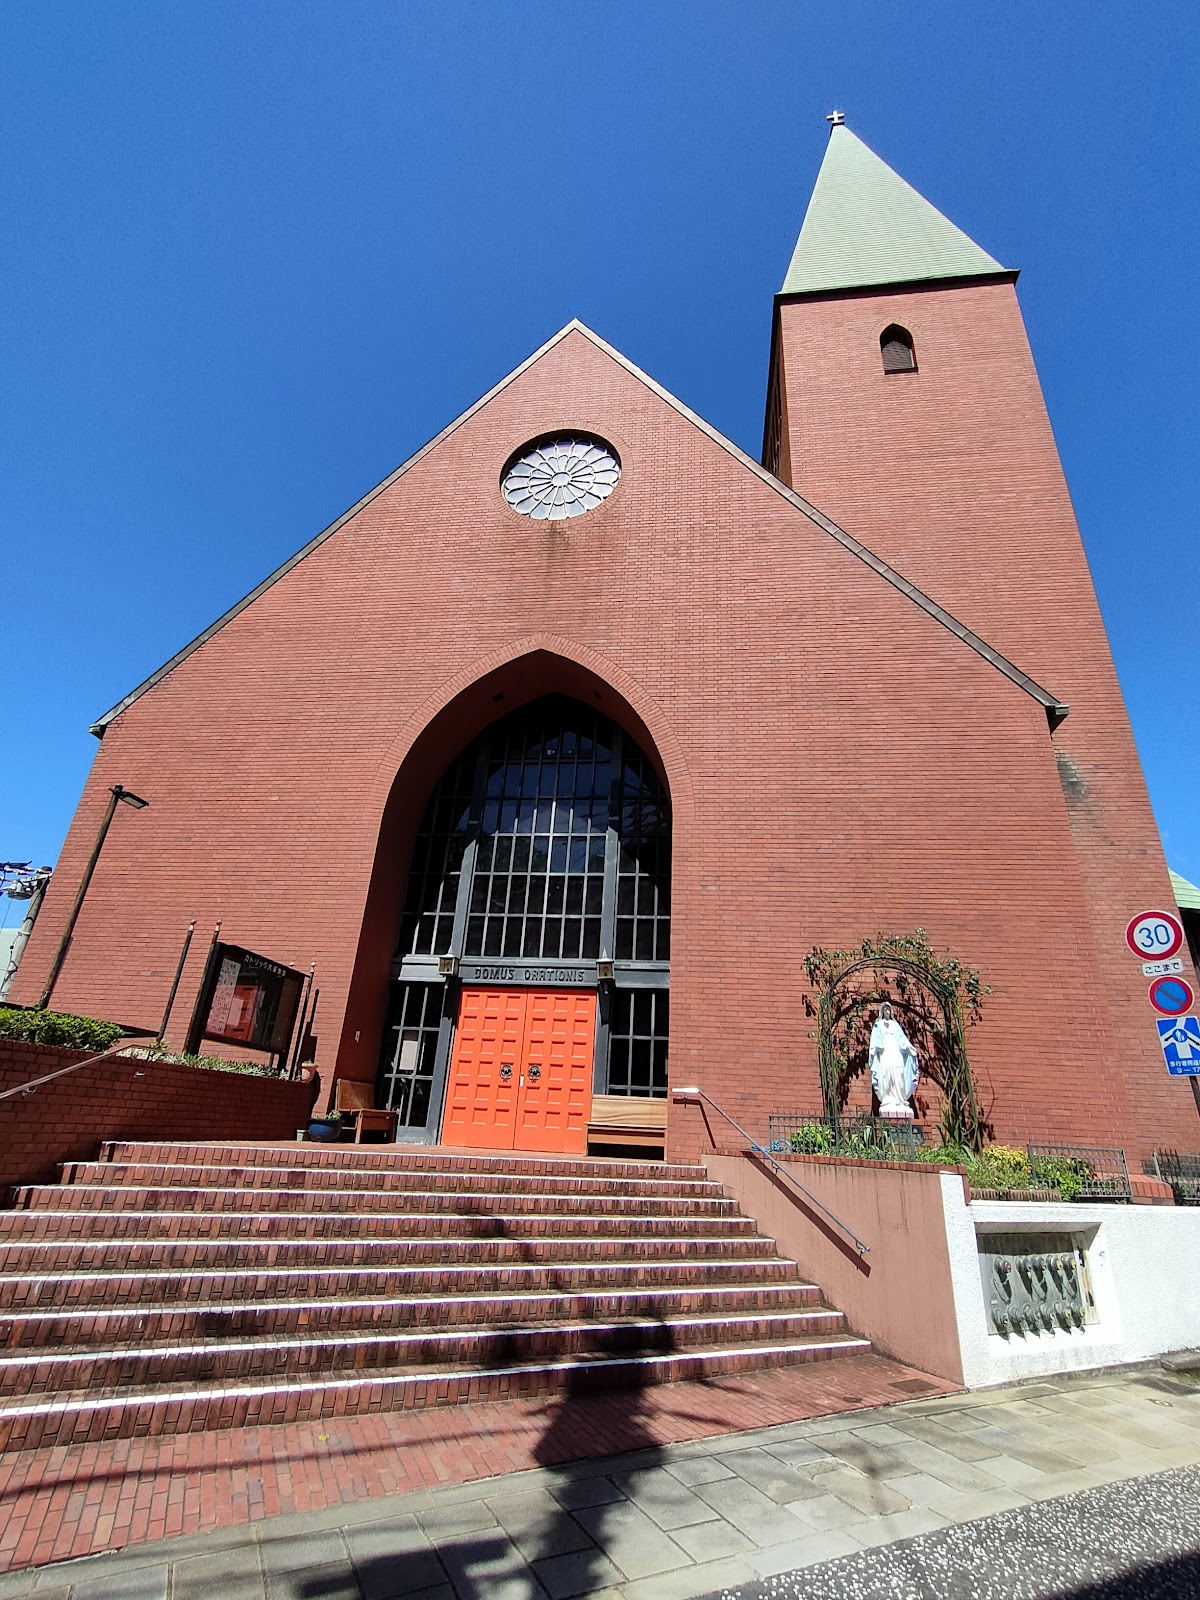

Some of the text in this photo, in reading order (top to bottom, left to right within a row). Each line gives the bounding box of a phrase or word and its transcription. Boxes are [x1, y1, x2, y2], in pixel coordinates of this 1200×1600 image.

[1139, 924, 1171, 948] 30
[1145, 962, 1180, 974] ここまで
[475, 968, 585, 982] DOMUS ORATIONIS
[1169, 1059, 1200, 1068] 歩行者用道
